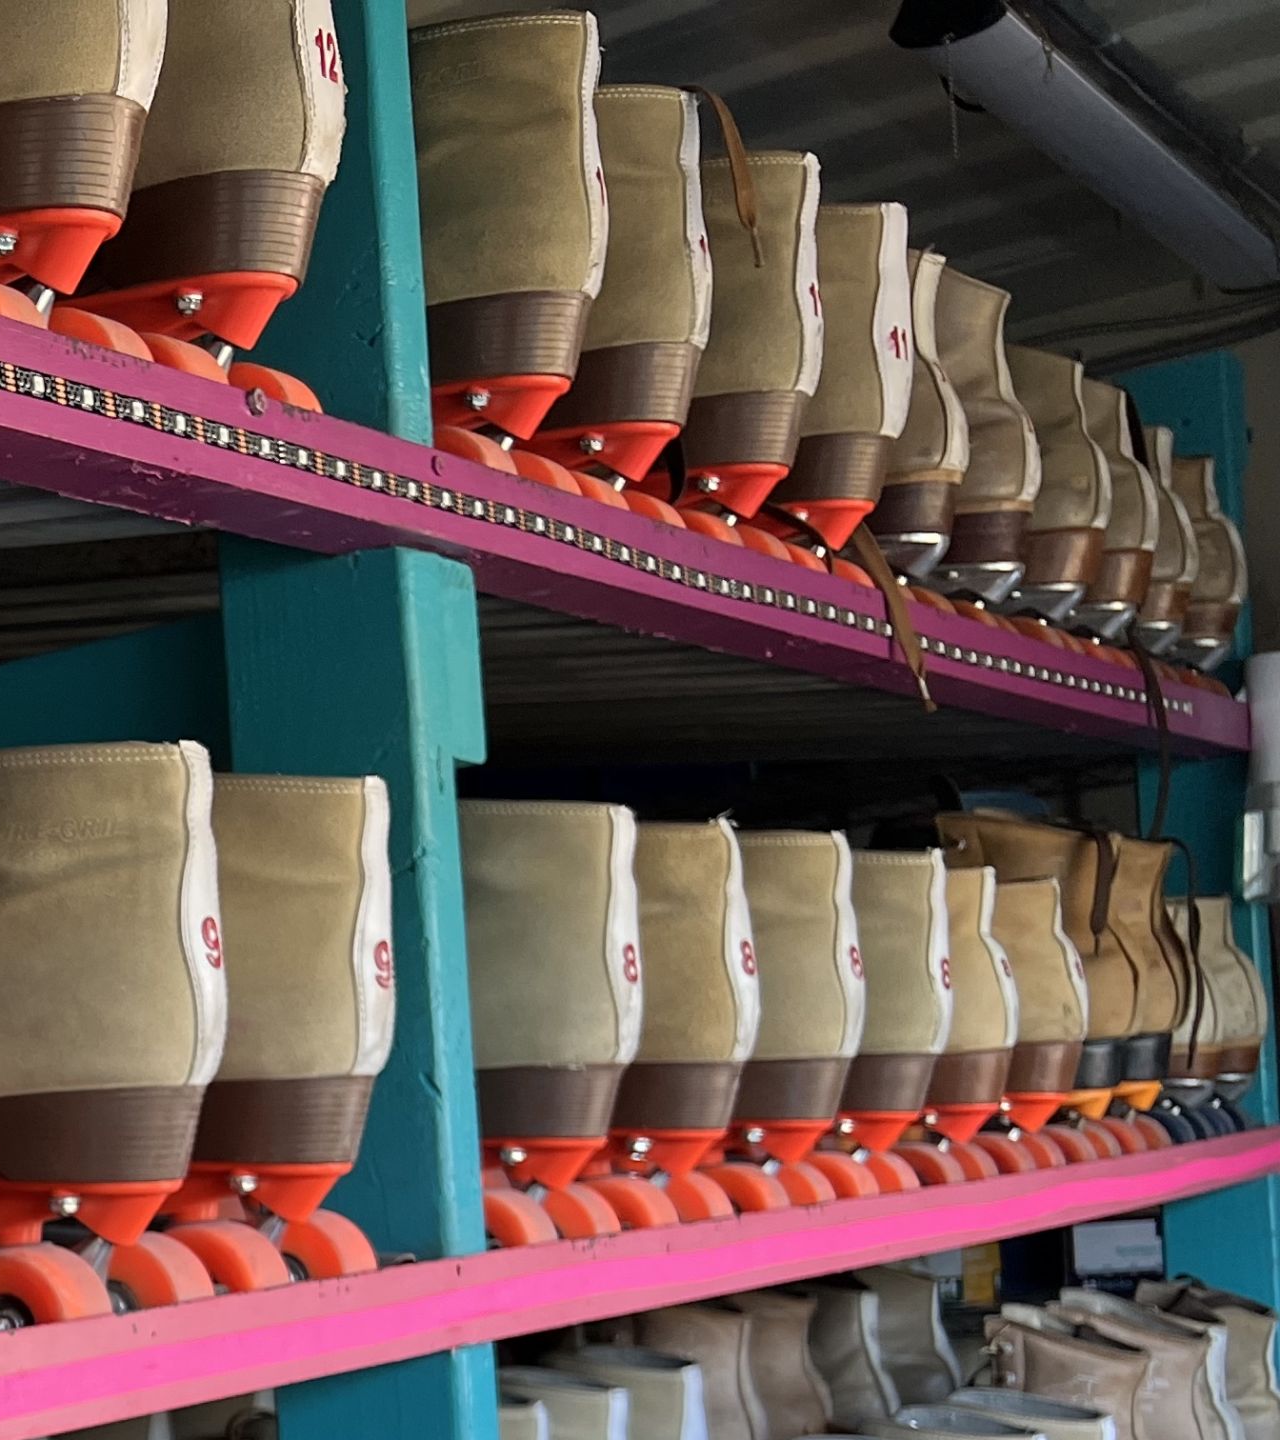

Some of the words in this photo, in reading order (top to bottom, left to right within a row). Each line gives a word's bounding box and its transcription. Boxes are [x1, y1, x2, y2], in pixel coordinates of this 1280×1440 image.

[313, 27, 341, 85] 12
[886, 325, 911, 361] 11
[202, 917, 224, 969] 9
[741, 940, 758, 975] 8
[849, 944, 863, 980] 8
[374, 940, 391, 992] 9
[624, 944, 640, 984] 8
